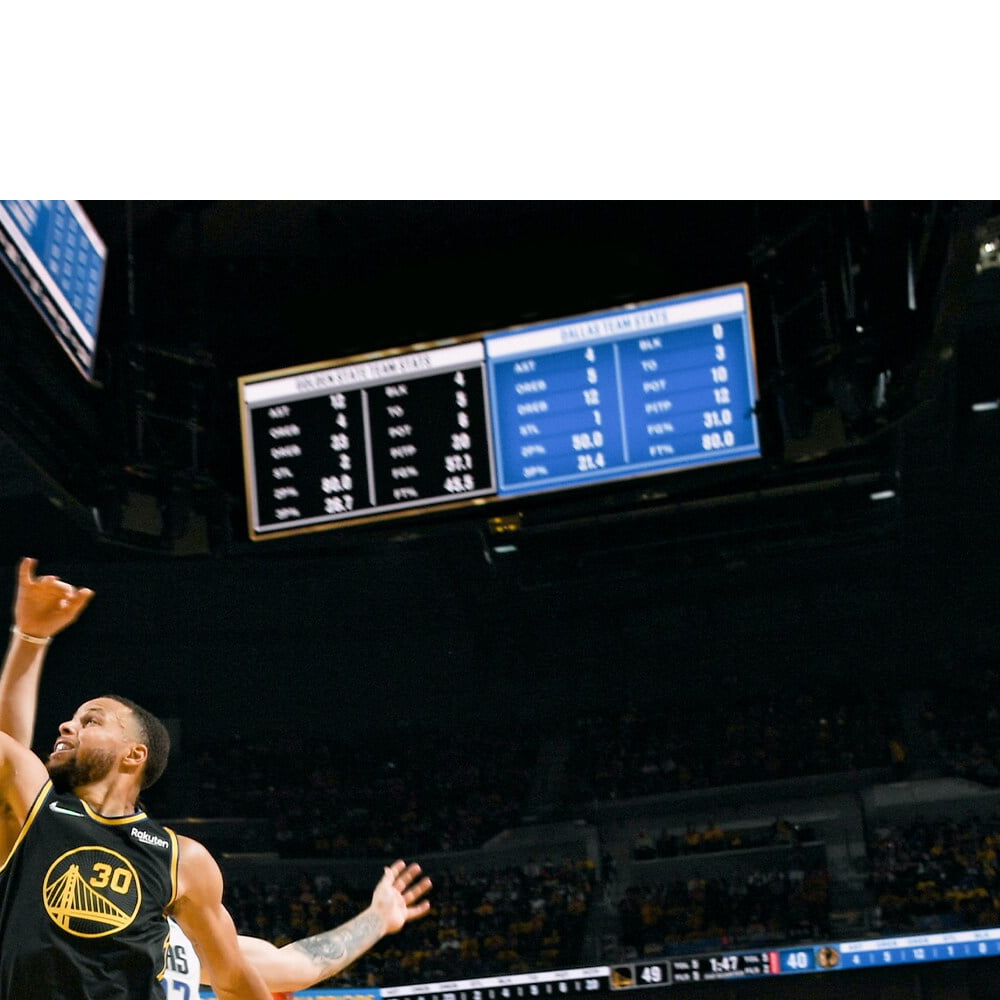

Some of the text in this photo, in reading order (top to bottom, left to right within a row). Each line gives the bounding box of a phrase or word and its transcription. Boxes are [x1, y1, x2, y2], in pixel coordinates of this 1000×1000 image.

[710, 365, 728, 383] 10
[703, 409, 733, 428] 31.0
[131, 827, 169, 849] Rakuten
[89, 862, 132, 895] 30
[786, 951, 808, 969] 40
